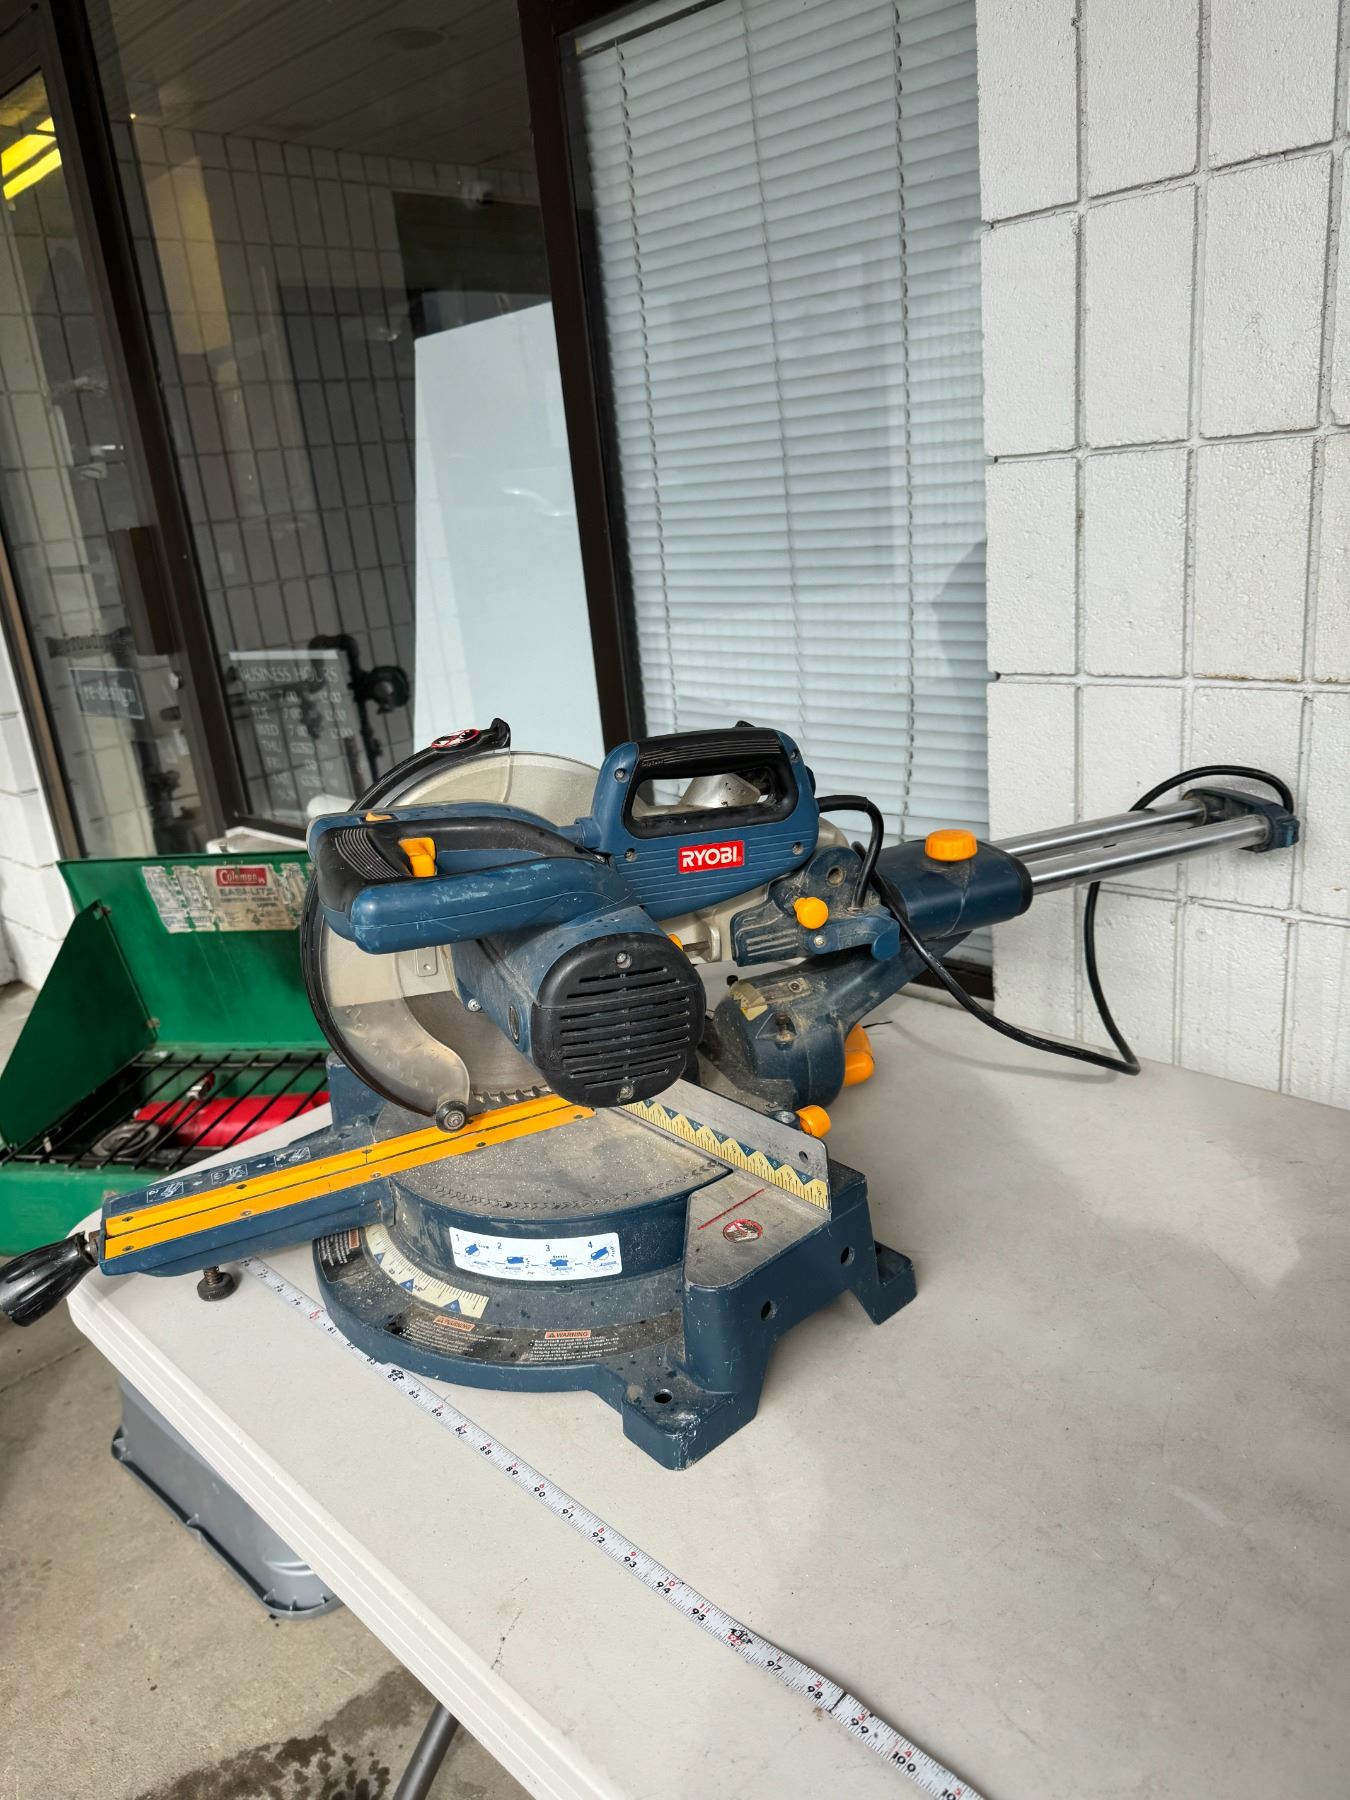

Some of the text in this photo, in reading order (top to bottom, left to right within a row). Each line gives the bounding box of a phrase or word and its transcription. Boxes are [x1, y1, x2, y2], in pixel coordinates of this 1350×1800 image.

[241, 666, 338, 682] BUSINESS HOURS
[681, 846, 737, 867] RYOBI
[220, 870, 258, 884] Coleman
[480, 1445, 492, 1456] 88
[506, 1466, 519, 1476] 89
[533, 1486, 546, 1498] 90
[562, 1508, 574, 1520] 91
[592, 1532, 606, 1544] 92
[623, 1556, 637, 1568] 93
[656, 1581, 672, 1594] 94
[691, 1608, 706, 1621] 95
[766, 1660, 783, 1672] 97
[807, 1685, 823, 1700] 98
[850, 1718, 869, 1735] 99
[892, 1751, 916, 1773] 100
